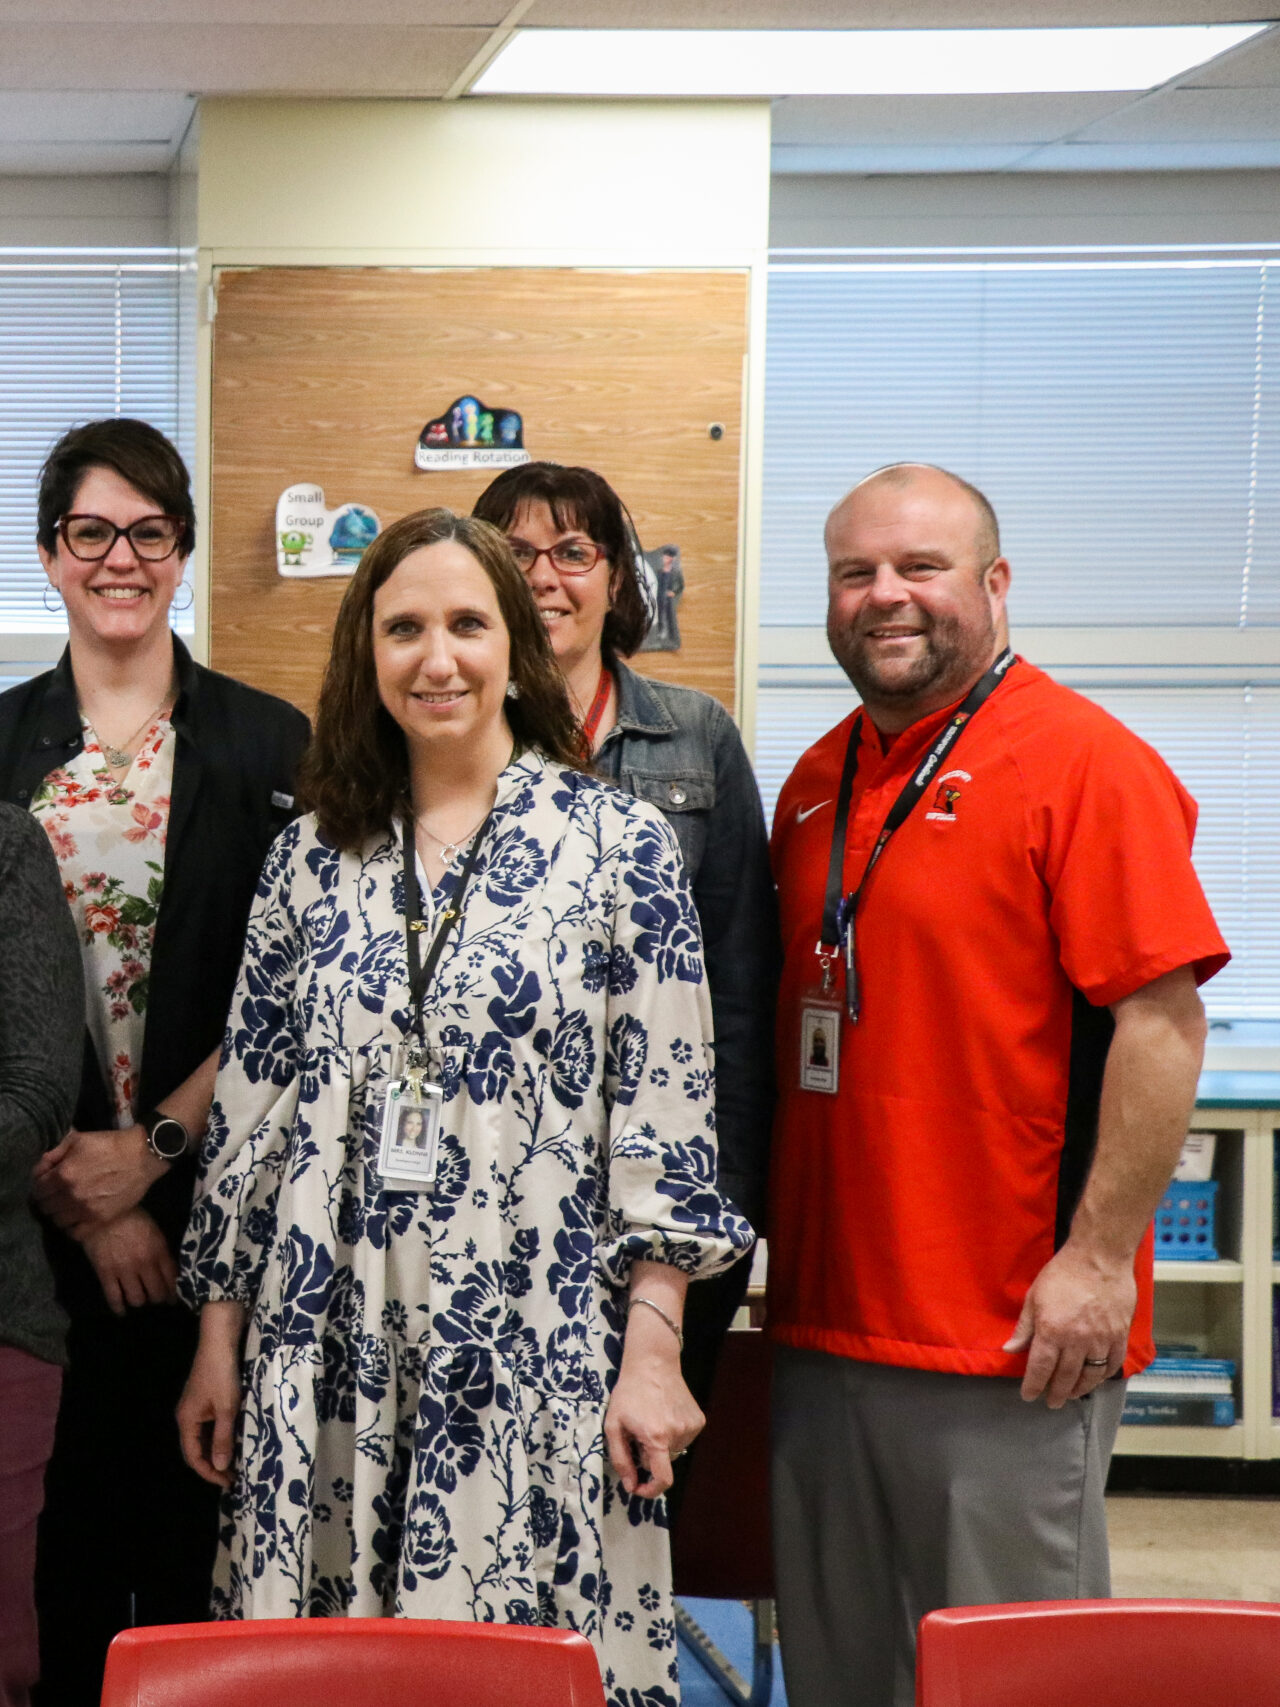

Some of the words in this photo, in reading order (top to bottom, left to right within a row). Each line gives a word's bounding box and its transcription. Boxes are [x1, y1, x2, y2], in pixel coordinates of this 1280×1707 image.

[473, 451, 529, 462] Rotation
[287, 491, 322, 503] Small
[286, 515, 324, 528] Group
